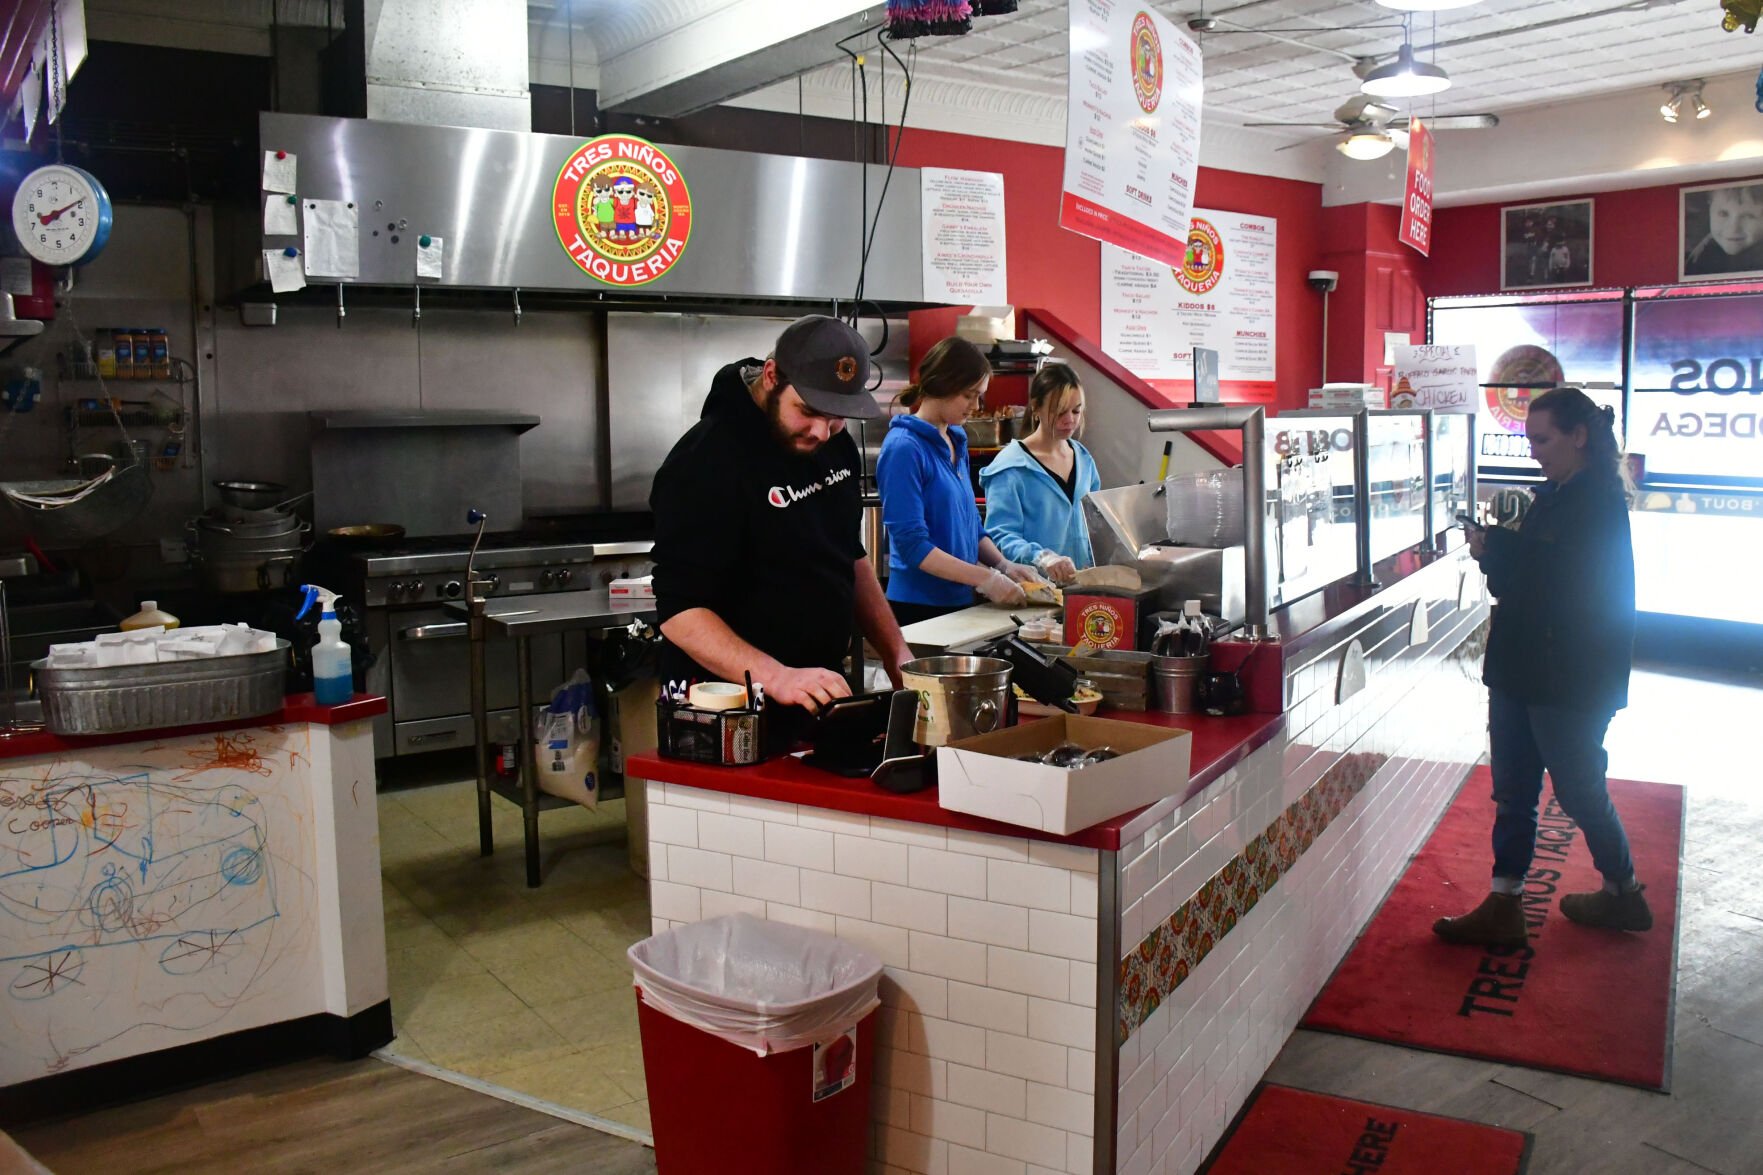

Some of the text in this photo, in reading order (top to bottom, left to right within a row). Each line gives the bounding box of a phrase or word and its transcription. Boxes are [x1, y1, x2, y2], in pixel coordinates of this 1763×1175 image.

[564, 142, 677, 186] TRES NIÑOS
[1126, 184, 1137, 196] SOFT
[1415, 169, 1431, 198] FOOD
[37, 190, 43, 198] 9
[1410, 193, 1431, 223] ORDER
[31, 222, 36, 230] 7
[79, 218, 84, 227] 3
[1240, 223, 1265, 231] COMBOS
[40, 234, 47, 243] 6
[70, 233, 76, 241] 4
[1196, 222, 1220, 245] NIÑOS
[1410, 219, 1428, 246] HERE
[56, 240, 62, 248] 5
[569, 234, 684, 282] TAQUERIA
[1236, 330, 1266, 338] MUNCHIES
[1416, 389, 1467, 406] CHICKEN
[1082, 605, 1119, 620] TRES NIÑOS
[1081, 633, 1120, 650] TAQUERIA
